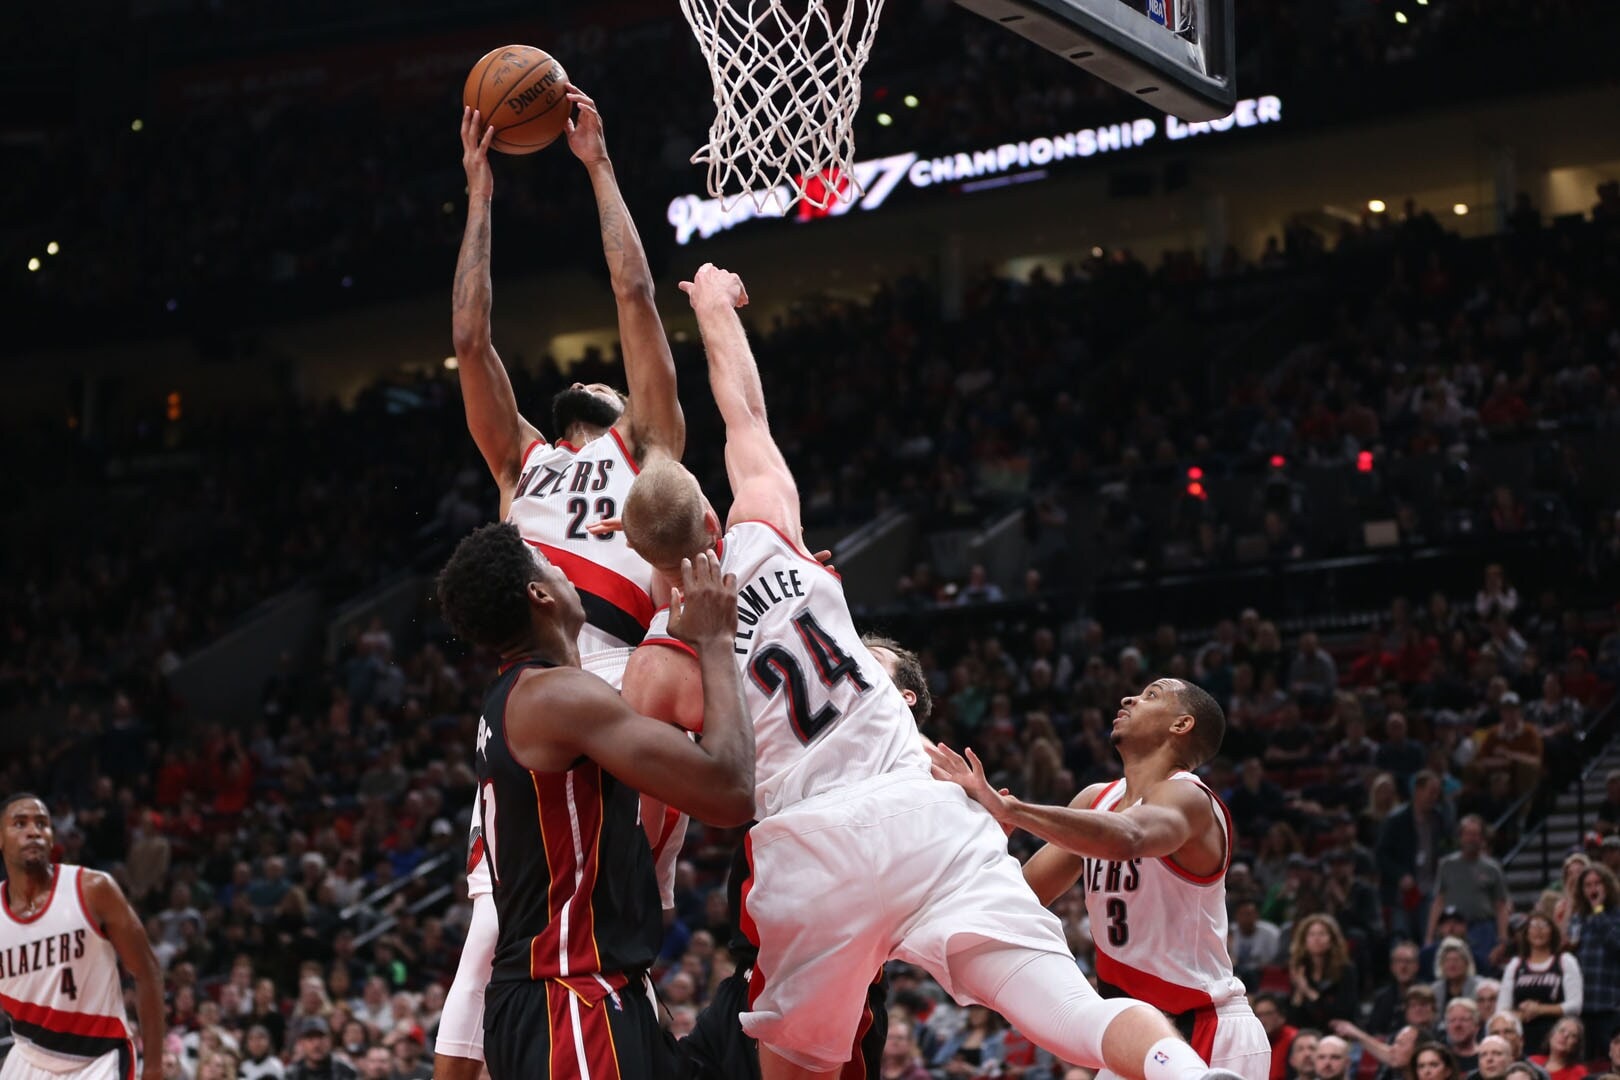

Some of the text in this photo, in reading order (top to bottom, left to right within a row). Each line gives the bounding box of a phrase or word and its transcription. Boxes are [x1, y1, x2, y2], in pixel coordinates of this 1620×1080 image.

[508, 62, 563, 114] PALDING
[909, 118, 1156, 187] CHAMPIONSHIP
[513, 459, 615, 501] AZERS
[566, 497, 616, 541] 23
[747, 607, 874, 748] 24
[1106, 897, 1129, 948] 3
[60, 967, 77, 1001] 4
